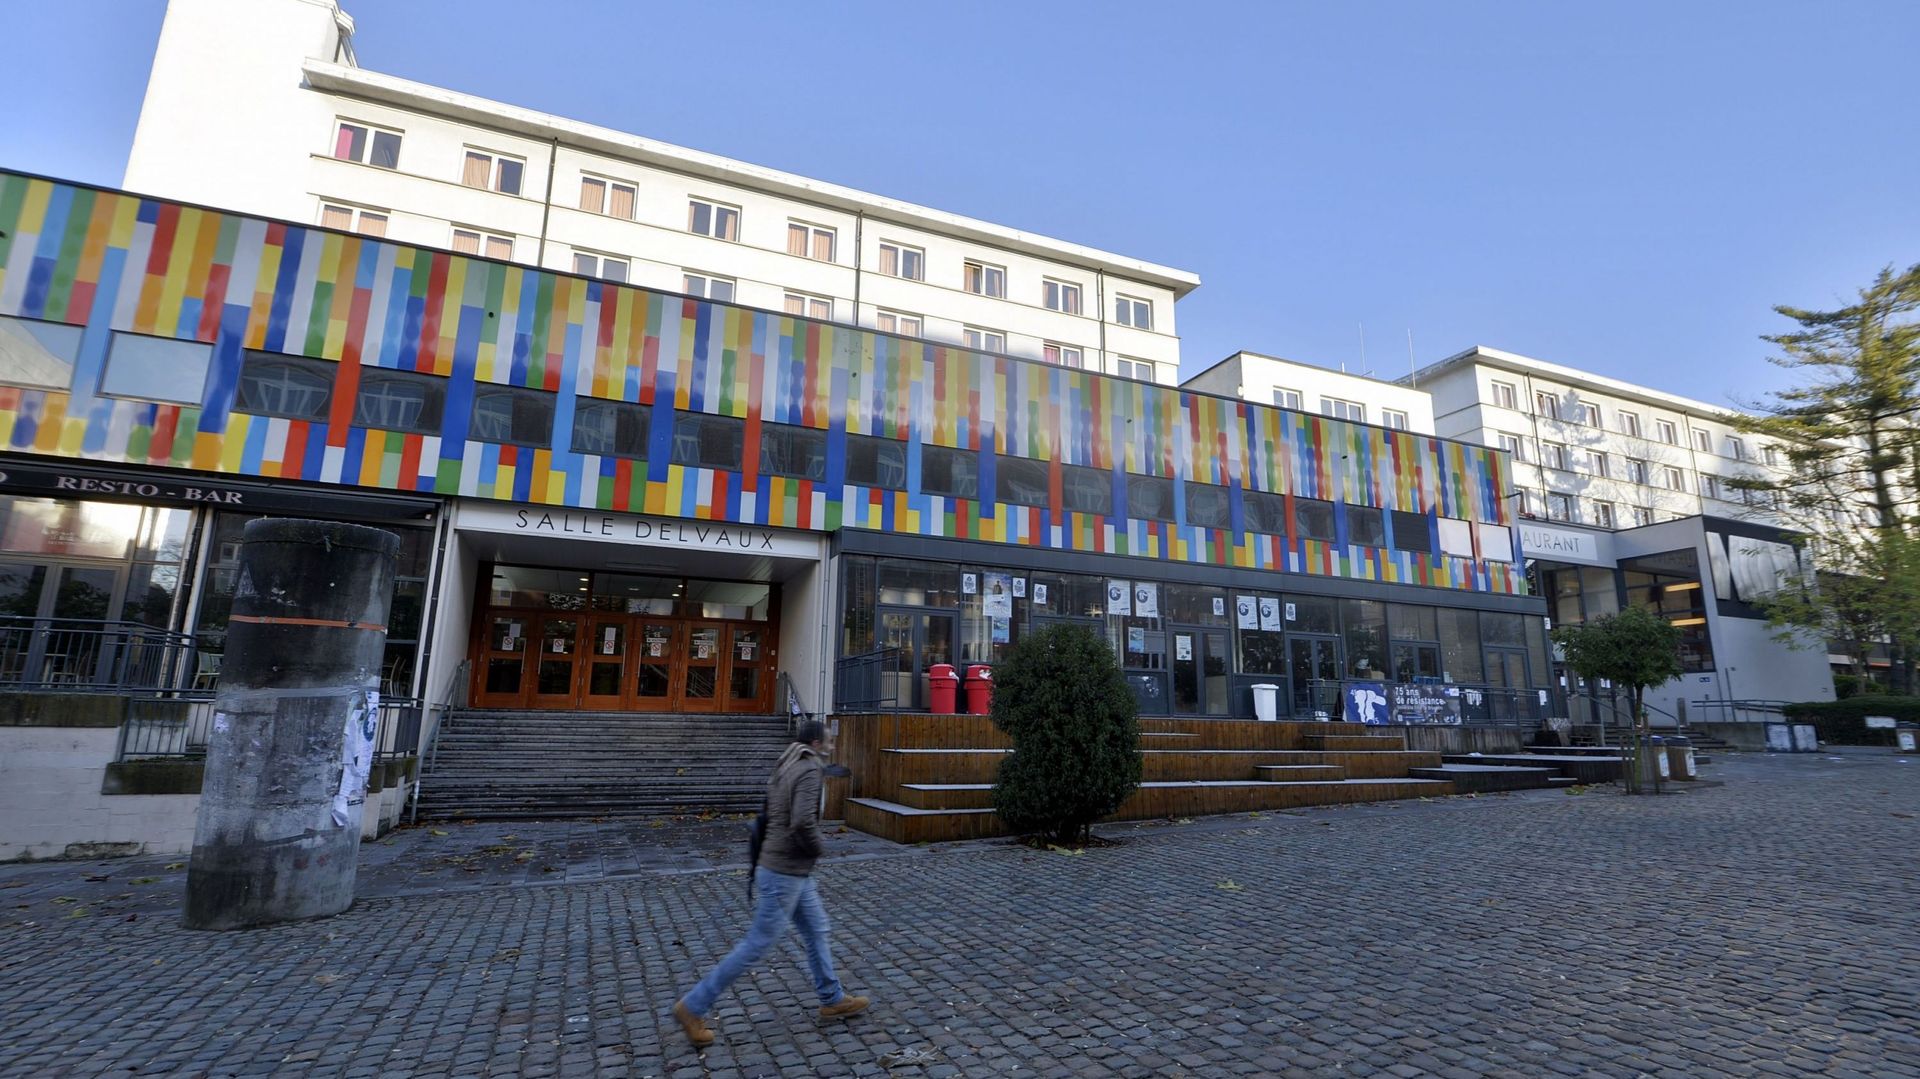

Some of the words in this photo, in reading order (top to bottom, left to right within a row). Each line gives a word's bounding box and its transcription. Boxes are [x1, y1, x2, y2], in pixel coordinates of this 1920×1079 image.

[56, 476, 158, 497] RESTO
[185, 487, 243, 504] BAR
[516, 510, 614, 536] SALLE
[636, 521, 773, 549] DELVAUX
[1395, 687, 1404, 696] 75
[1406, 688, 1419, 696] ans
[1396, 695, 1405, 705] de
